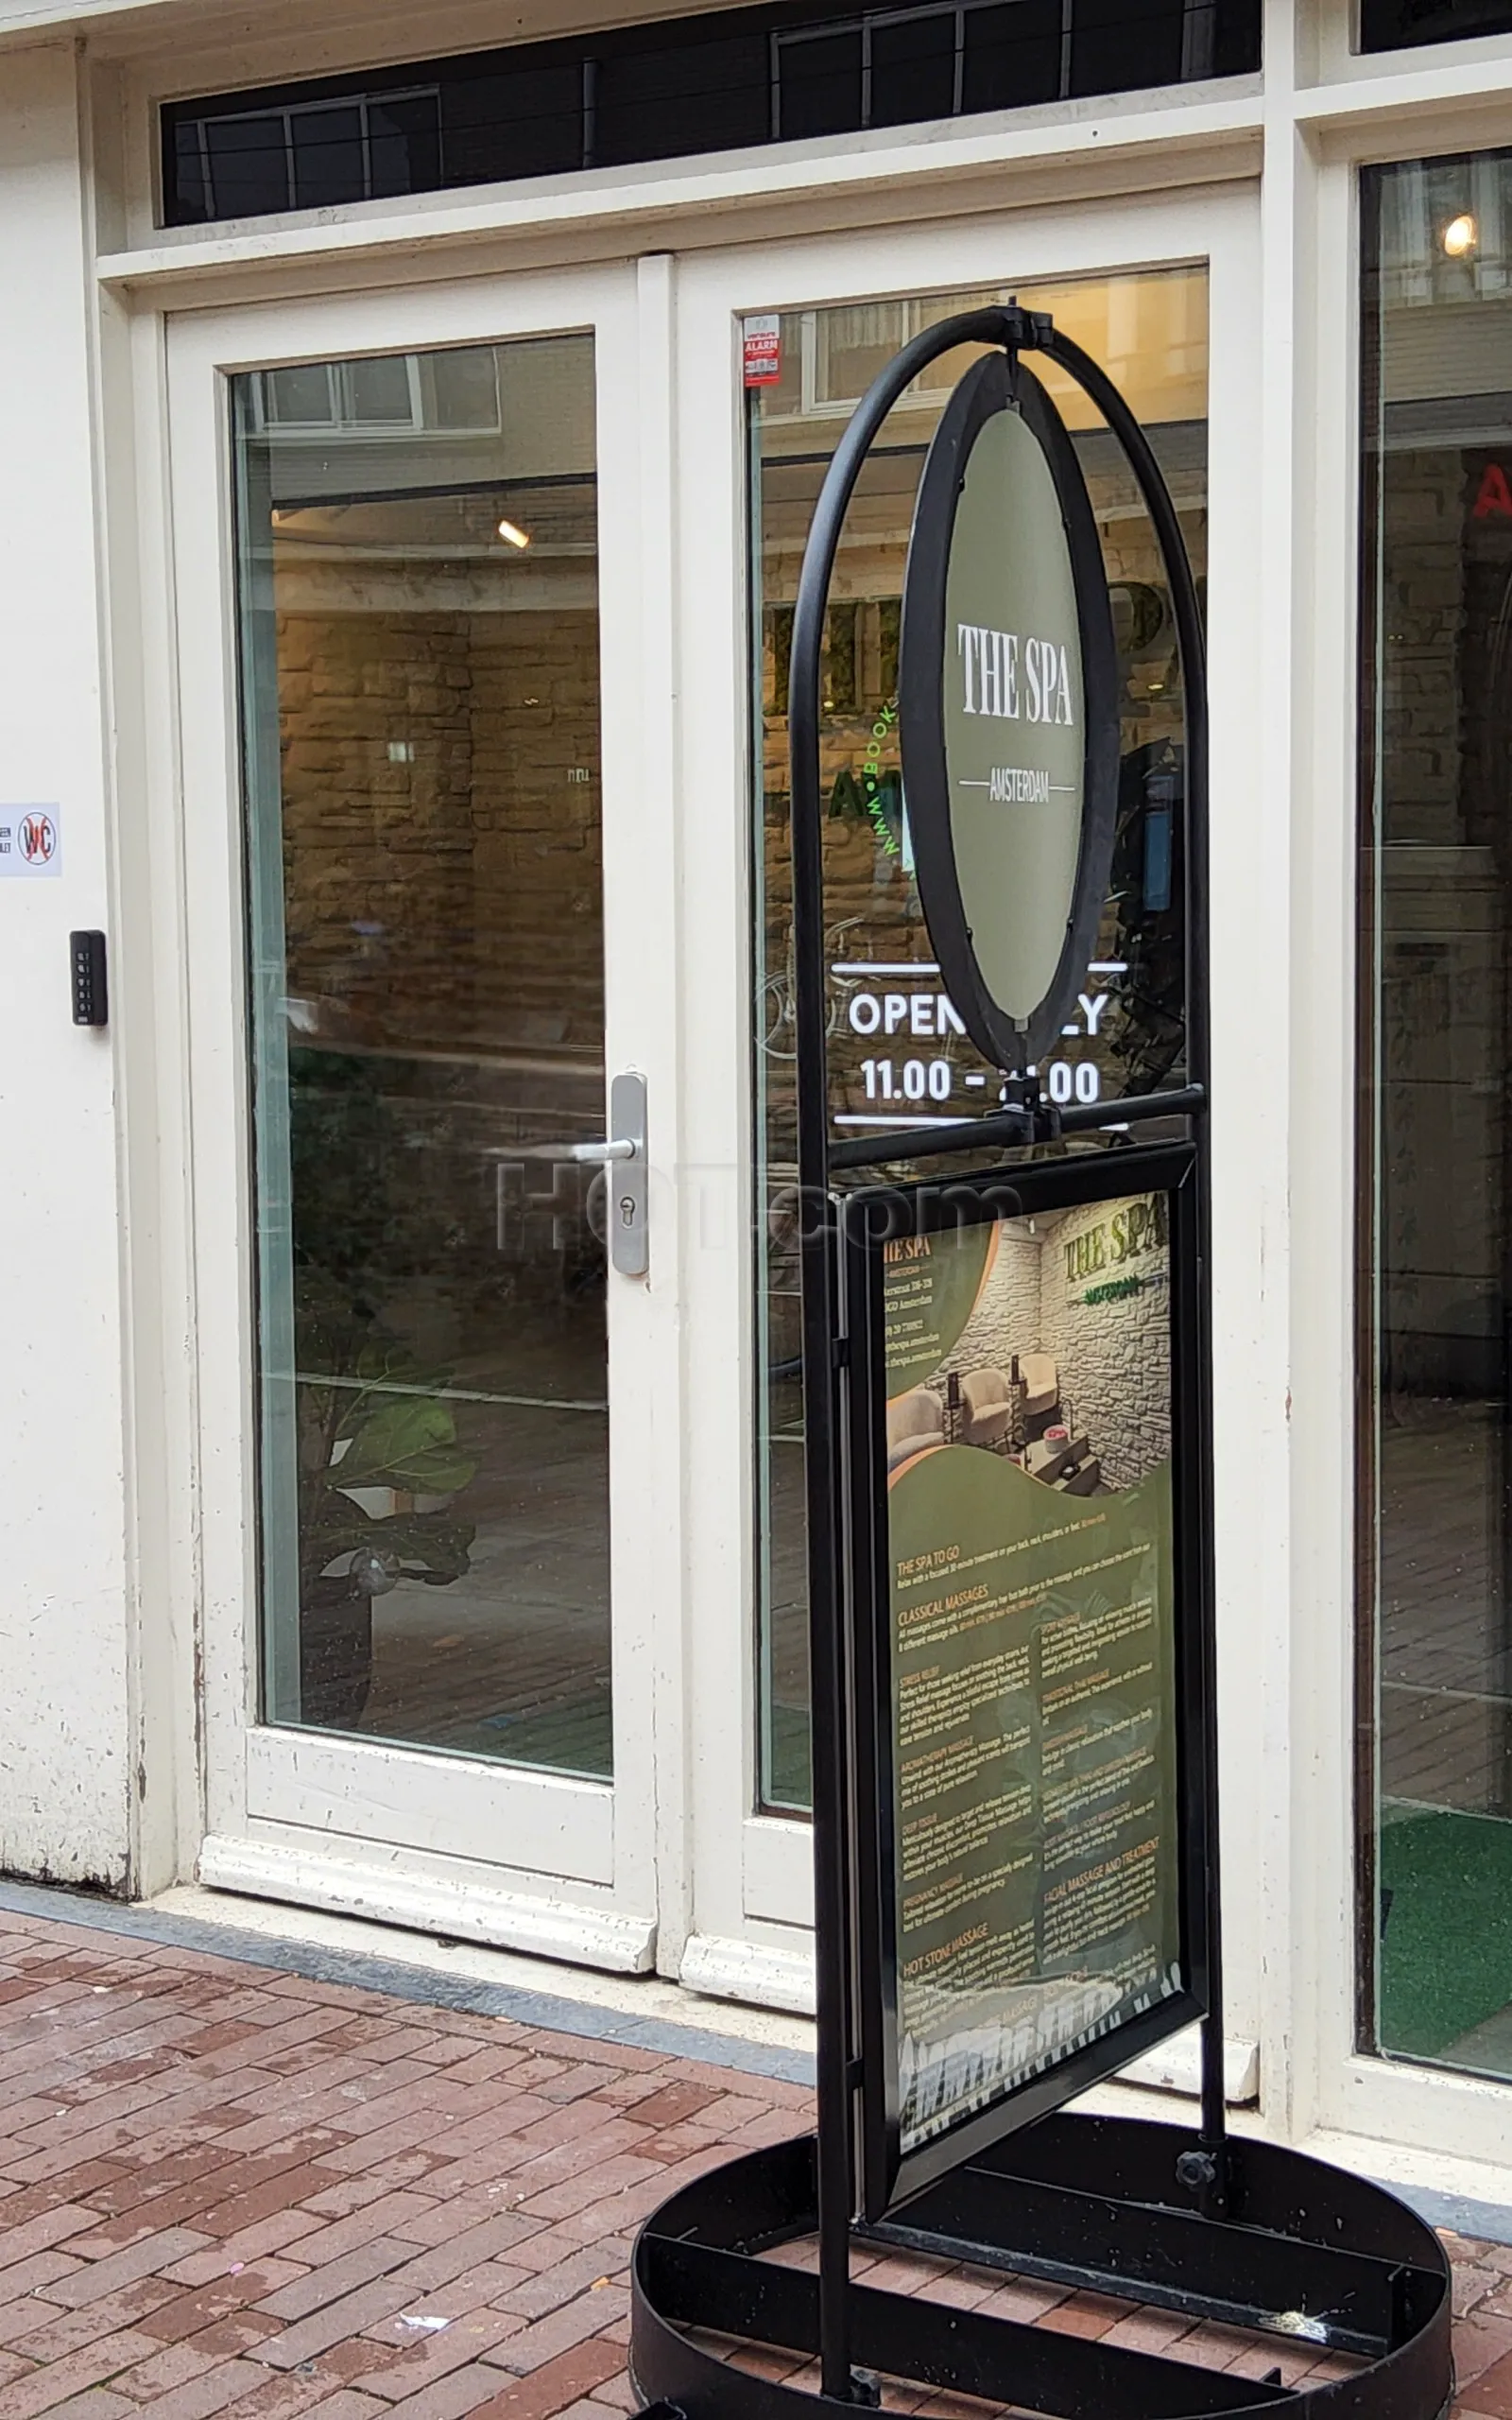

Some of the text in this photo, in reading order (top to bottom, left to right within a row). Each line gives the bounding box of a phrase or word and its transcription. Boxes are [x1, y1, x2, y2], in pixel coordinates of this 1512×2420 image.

[745, 339, 778, 351] ALARM
[957, 623, 1074, 726] THE SPA
[990, 768, 1049, 803] AMSTERDAM
[850, 994, 967, 1035] OPEN
[860, 1059, 951, 1100] 11.00
[904, 1236, 931, 1260] SPA
[1062, 1192, 1169, 1282] THE SPA
[897, 1545, 960, 1576] THE SPA TO GO
[898, 1599, 944, 1627] CLASSICAL
[945, 1583, 989, 1611] MASSAGES
[902, 1922, 988, 1977] HOT STONE MASSAGE
